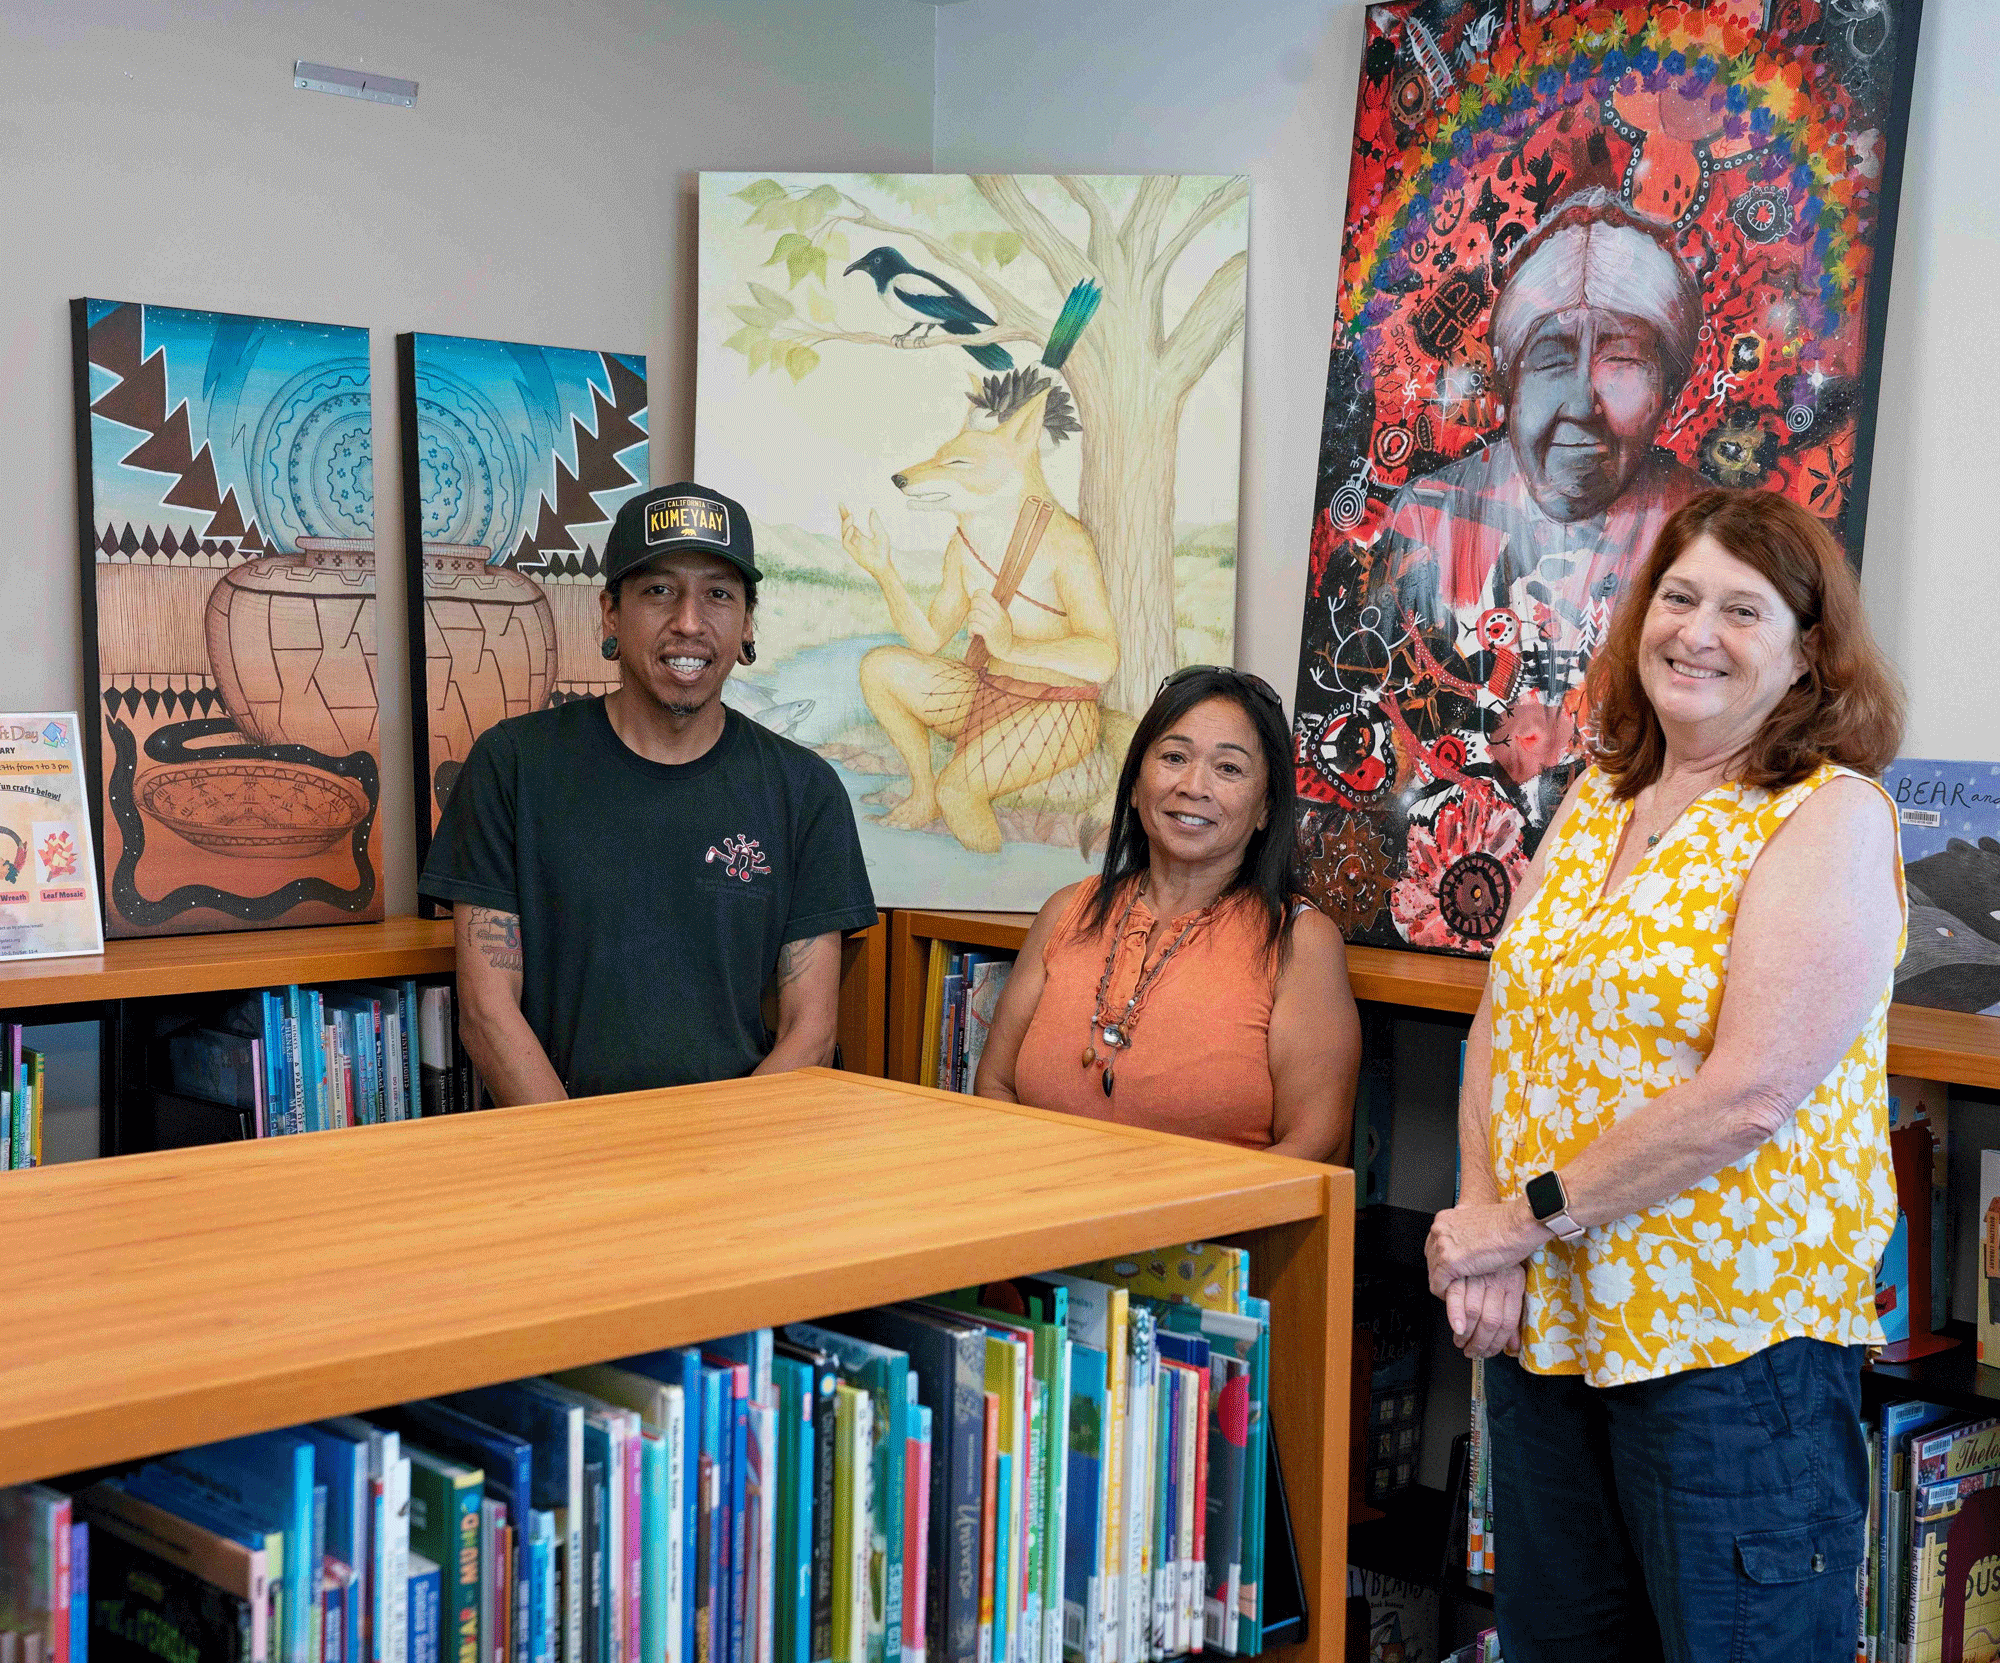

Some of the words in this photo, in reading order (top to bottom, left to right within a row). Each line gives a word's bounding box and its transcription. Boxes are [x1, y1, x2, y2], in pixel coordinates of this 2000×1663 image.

[667, 499, 706, 508] CALIFORNIA
[651, 508, 723, 532] KUMEYAAY
[10, 725, 39, 744] Day
[16, 763, 34, 772] from
[58, 763, 70, 772] pm
[12, 785, 35, 794] crafts
[36, 787, 61, 801] below!
[1896, 777, 1971, 808] BEAR
[0, 894, 27, 902] Wreath
[285, 1026, 293, 1062] HENKES
[401, 1031, 409, 1059] WINTER
[955, 1496, 981, 1600] Universo
[1879, 1535, 1888, 1569] STARS
[1909, 1564, 1919, 1603] SUBWAY
[1907, 1605, 1916, 1640] MOUSE
[886, 1626, 902, 1658] ECO
